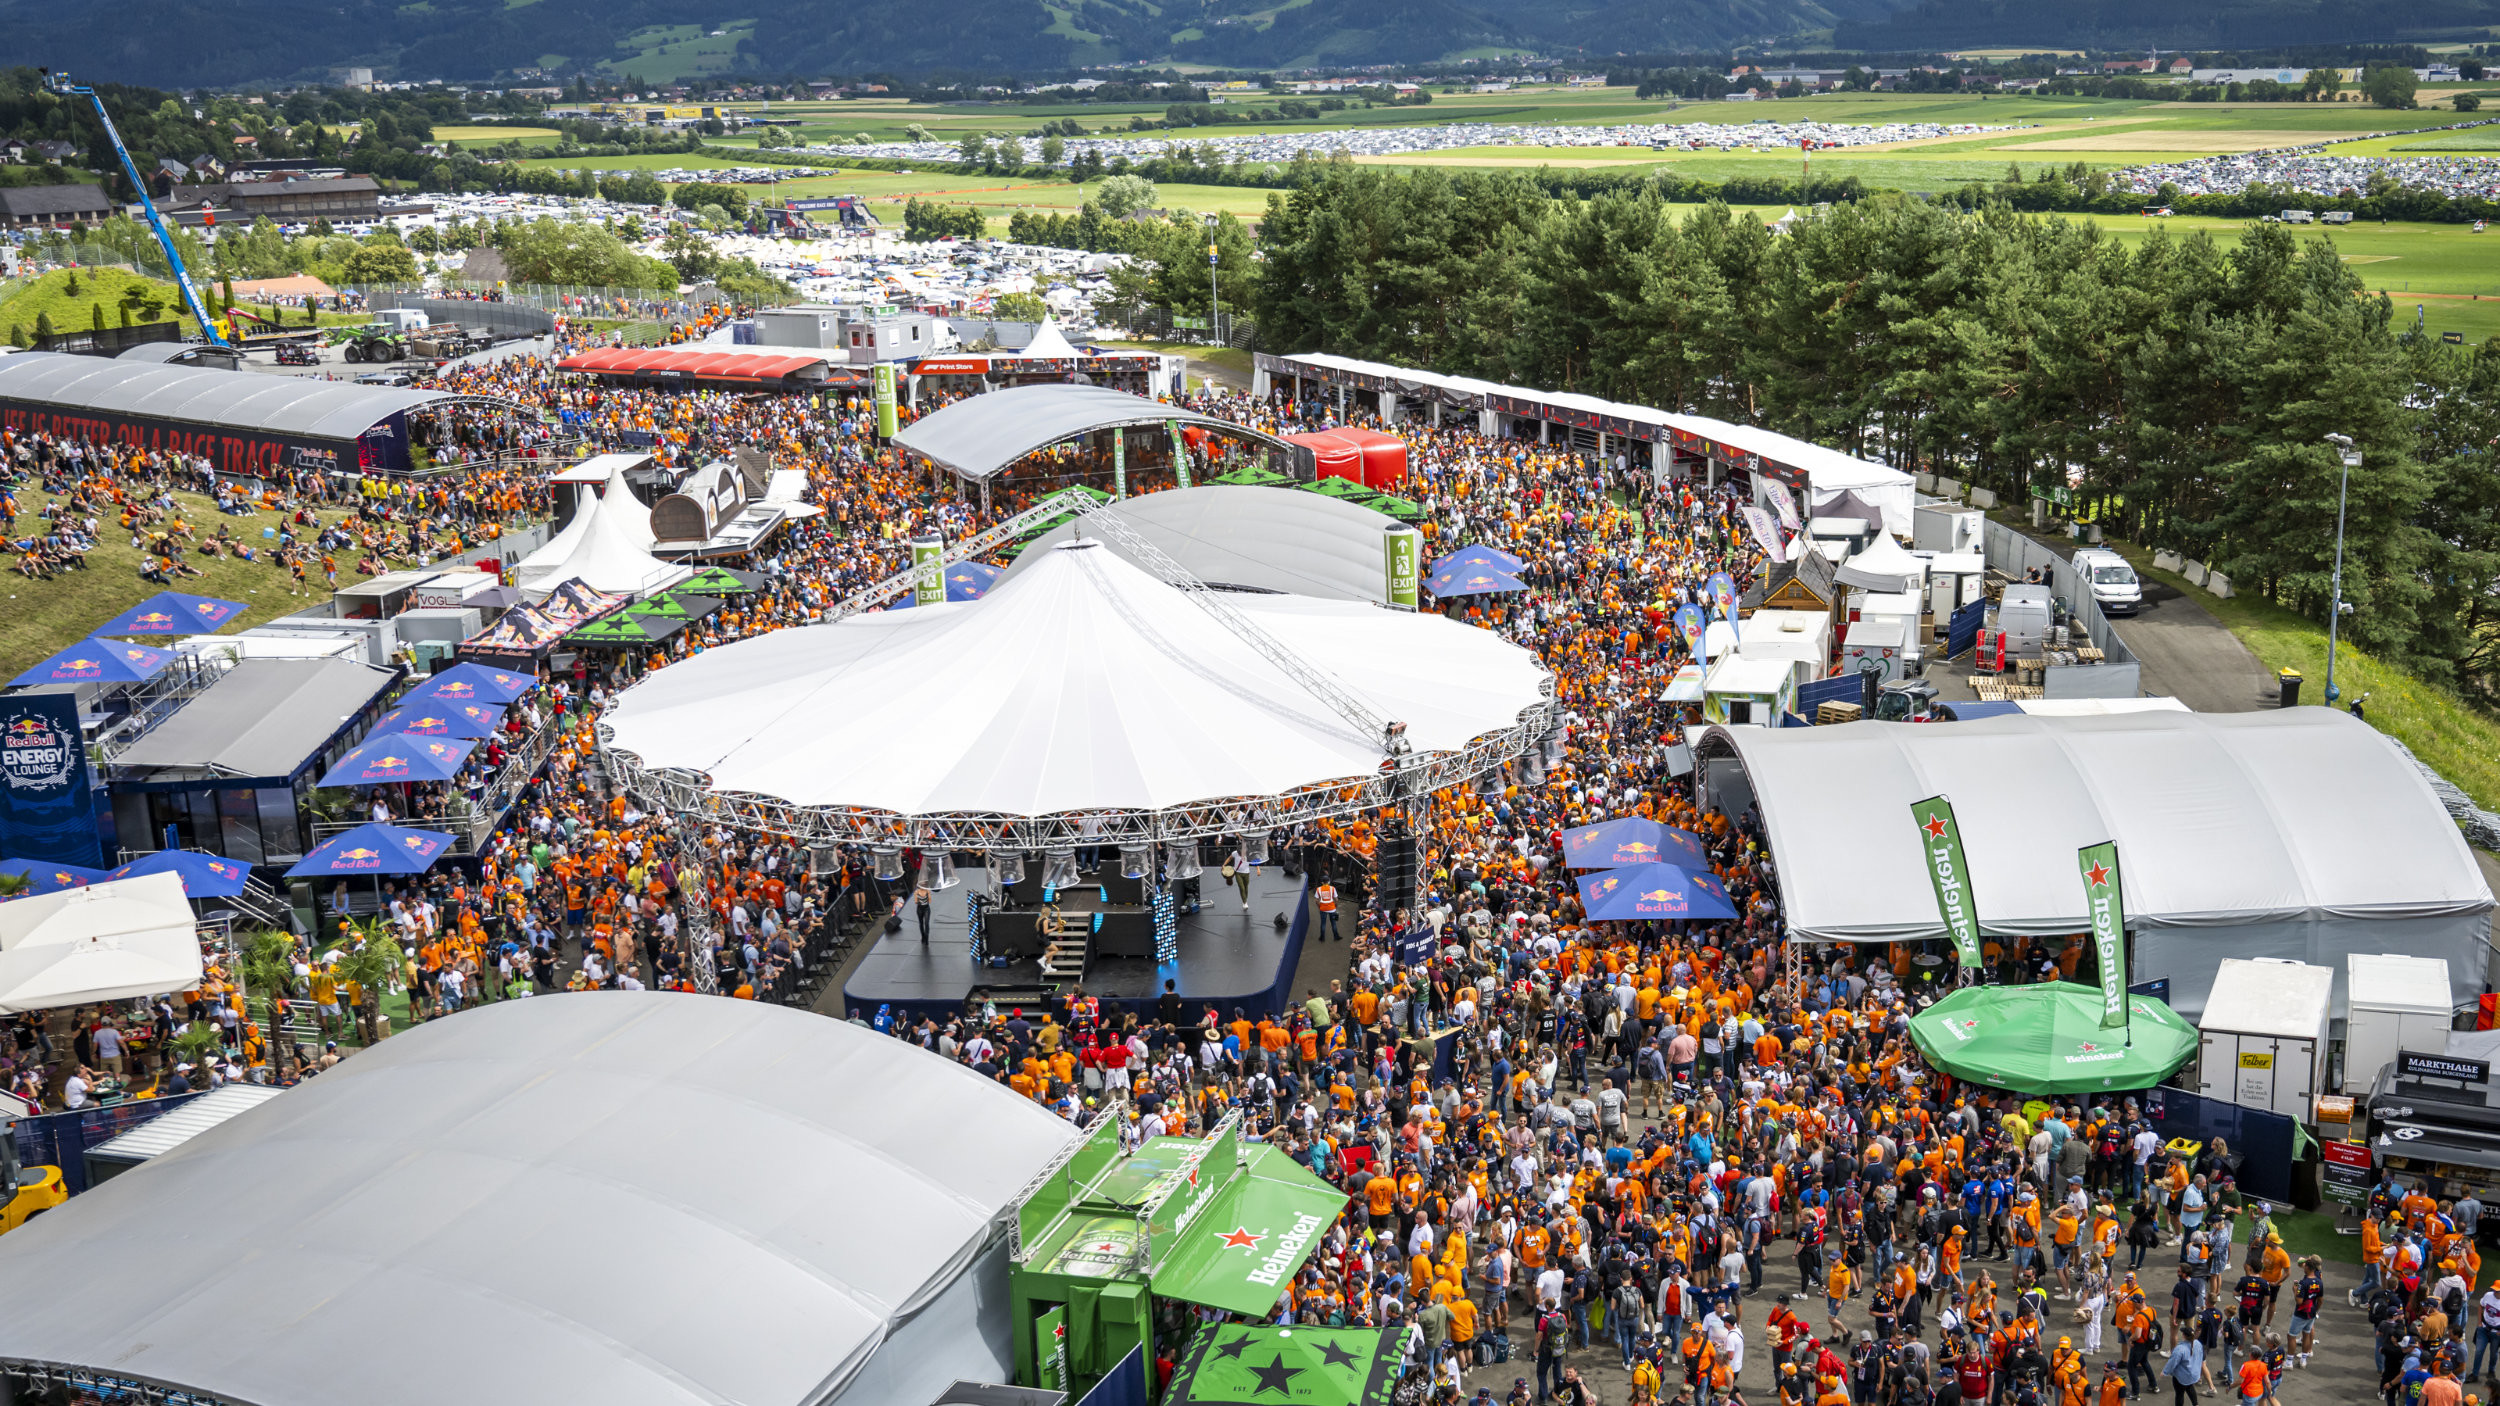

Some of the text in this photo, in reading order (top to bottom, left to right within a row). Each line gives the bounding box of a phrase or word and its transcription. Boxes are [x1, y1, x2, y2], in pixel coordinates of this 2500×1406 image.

[179, 271, 211, 327] FELBERMAYR
[877, 393, 893, 401] EXIT
[222, 436, 284, 477] TRACK
[1392, 577, 1415, 588] EXIT
[1465, 582, 1499, 591] Red Bull
[919, 589, 942, 600] EXIT
[420, 596, 448, 605] VOGL
[129, 622, 173, 631] Red Bull
[52, 669, 101, 678] Red Bull
[425, 726, 448, 735] Bull
[6, 733, 56, 748] Red Bull
[3, 748, 63, 765] ENERGY
[14, 763, 58, 775] LOUNGE
[361, 767, 409, 778] Red Bull
[1612, 853, 1662, 863] Red Bull
[330, 859, 381, 869] Red Bull
[1636, 902, 1688, 912] Red Bull
[2064, 1051, 2122, 1064] Heineken
[2242, 1055, 2269, 1066] Felber
[2408, 1058, 2479, 1073] MARKTHALLE
[2407, 1066, 2479, 1079] KULINARIUM BURGENLAND
[1175, 1183, 1214, 1236] Heineken
[1246, 1213, 1322, 1287] Heineken
[1057, 1250, 1135, 1265] Heineken
